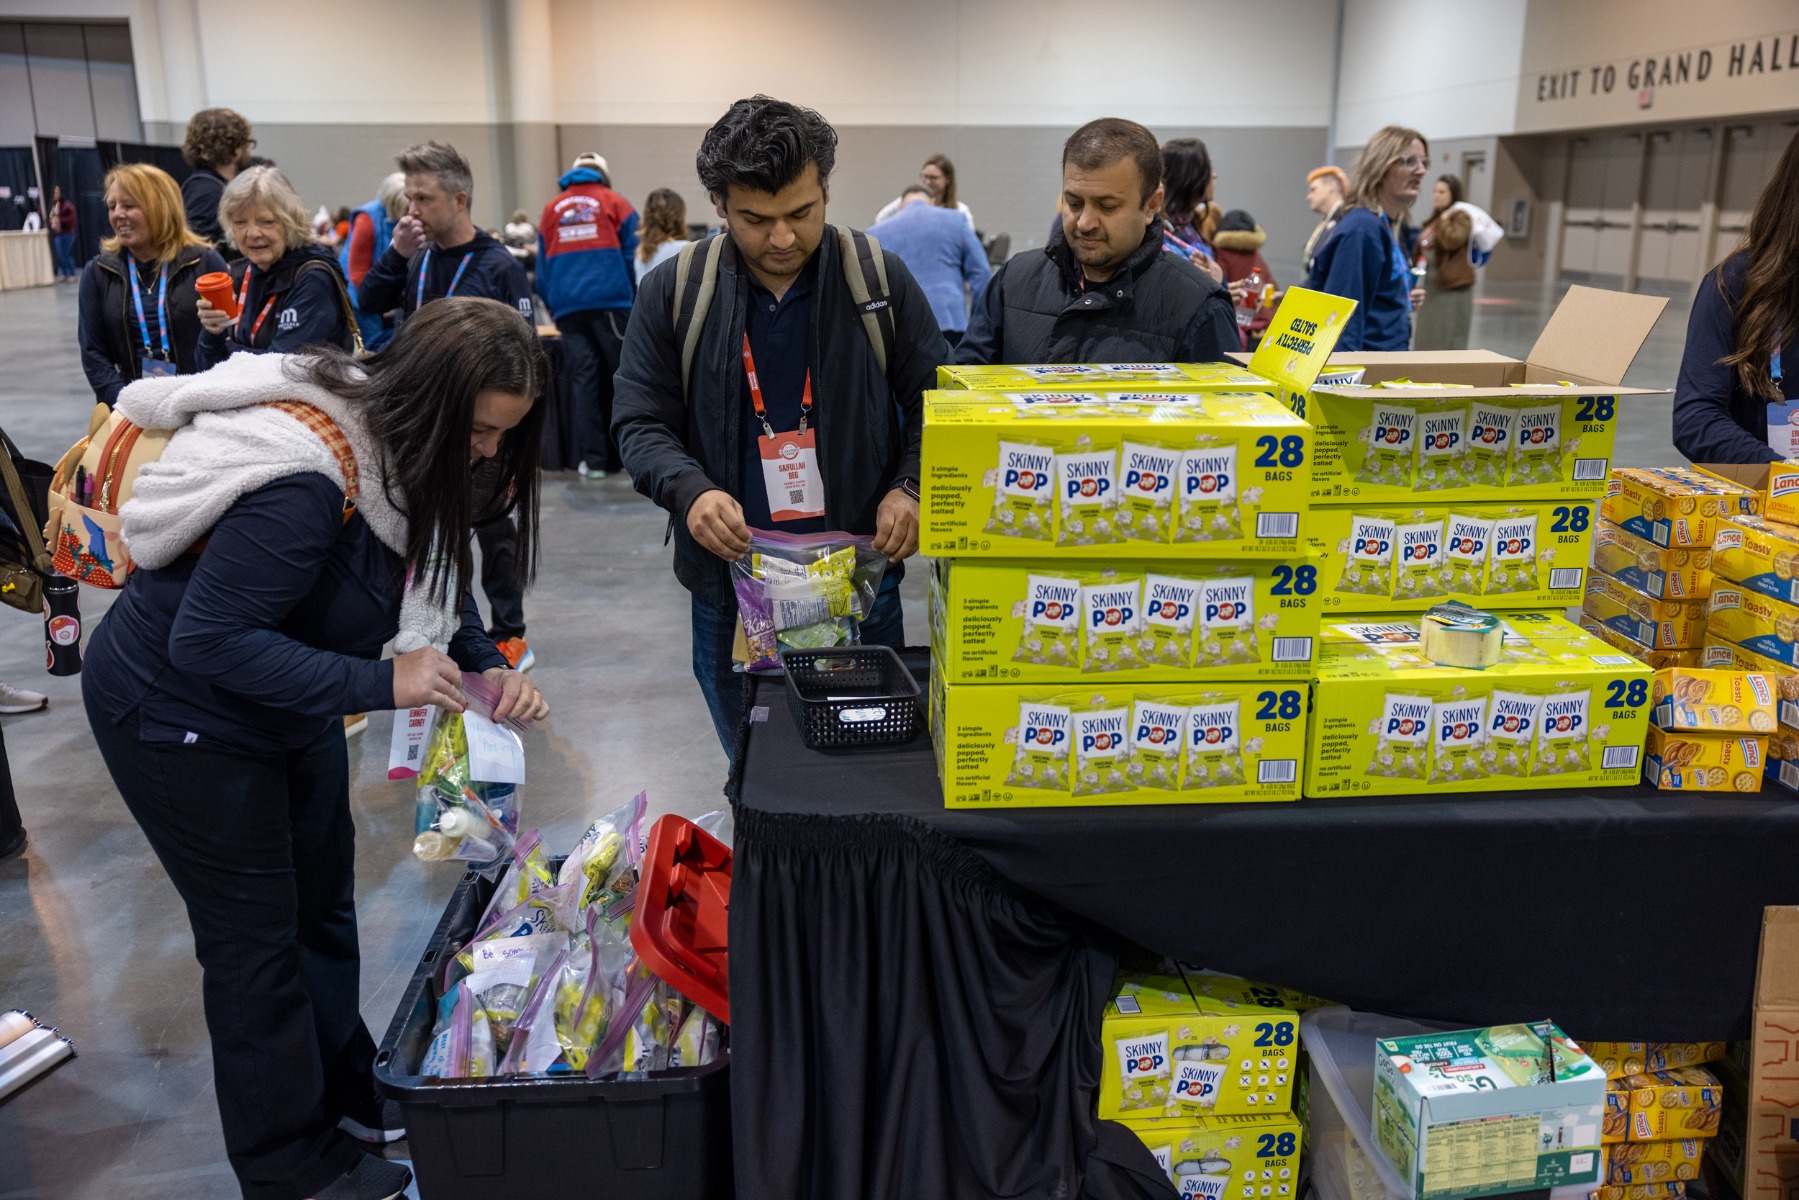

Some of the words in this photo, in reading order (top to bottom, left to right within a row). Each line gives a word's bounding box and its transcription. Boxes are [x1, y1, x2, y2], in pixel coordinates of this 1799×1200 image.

[1537, 70, 1581, 102] EXIT
[1591, 65, 1616, 95] TO
[1628, 49, 1713, 90] GRAND
[1728, 34, 1799, 77] HALL
[866, 300, 888, 311] adidas
[1290, 318, 1318, 337] SALTED
[1275, 332, 1315, 356] PERFECTLY
[1575, 396, 1615, 422] 28
[1375, 427, 1410, 444] POP
[1472, 425, 1506, 444] POP
[1520, 427, 1555, 445] POP
[1582, 424, 1605, 433] BAGS
[1425, 433, 1459, 450] POP
[1254, 435, 1304, 468] 28
[788, 472, 799, 480] BEG
[1005, 469, 1048, 491] POP
[1126, 470, 1169, 493] POP
[1187, 474, 1229, 494] POP
[1265, 471, 1292, 481] BAGS
[1773, 477, 1799, 491] Lanc
[931, 485, 972, 493] deliciously
[1068, 478, 1110, 498] POP
[1623, 485, 1642, 501] Toasty
[931, 500, 965, 508] perfectly
[1550, 506, 1589, 533] 28
[1558, 535, 1579, 543] BAGS
[1679, 520, 1687, 544] Lance
[1696, 519, 1704, 543] Toasty
[1718, 532, 1741, 545] Lance
[1355, 538, 1389, 555] POP
[1404, 544, 1437, 561] POP
[1450, 537, 1484, 555] POP
[1497, 538, 1530, 555] POP
[1744, 536, 1771, 556] Toasty
[1270, 564, 1317, 595] 28
[1672, 572, 1680, 596] Lance
[1689, 571, 1697, 595] Toasty
[1280, 599, 1306, 608] BAGS
[1714, 593, 1740, 605] Lance
[1743, 597, 1773, 617] Toasty
[1033, 600, 1074, 620] POP
[1093, 607, 1133, 627] POP
[1148, 600, 1189, 621] POP
[1206, 602, 1247, 621] POP
[963, 616, 1002, 624] deliciously
[963, 630, 995, 638] perfectly
[1664, 623, 1673, 646] Lance
[1680, 622, 1689, 644] Toasty
[1707, 647, 1731, 660] Lance
[1604, 679, 1648, 708] 28
[1734, 676, 1743, 704] Toasty
[1752, 676, 1768, 704] Lance
[1255, 690, 1301, 720] 28
[1492, 715, 1530, 733] POP
[1545, 715, 1582, 733] POP
[1612, 710, 1636, 720] BAGS
[1025, 727, 1065, 745] POP
[1137, 725, 1177, 745] POP
[1193, 726, 1233, 745] POP
[1265, 723, 1291, 732] BAGS
[1387, 718, 1426, 735] POP
[1442, 722, 1479, 741] POP
[957, 742, 995, 750] deliciously
[1083, 733, 1122, 752] POP
[1321, 747, 1351, 755] perfectly
[1723, 739, 1734, 765] Toasty
[957, 756, 989, 765] perfectly
[1745, 739, 1757, 766] Lance
[482, 950, 494, 960] Be
[1253, 1021, 1294, 1047] 28
[1262, 1048, 1285, 1057] BAGS
[1126, 1054, 1164, 1073] POP
[1176, 1080, 1214, 1097] POP
[1638, 1113, 1647, 1137] Lance
[1656, 1110, 1665, 1135] Toasty
[1256, 1132, 1296, 1158] 28
[1265, 1159, 1287, 1167] BAGS
